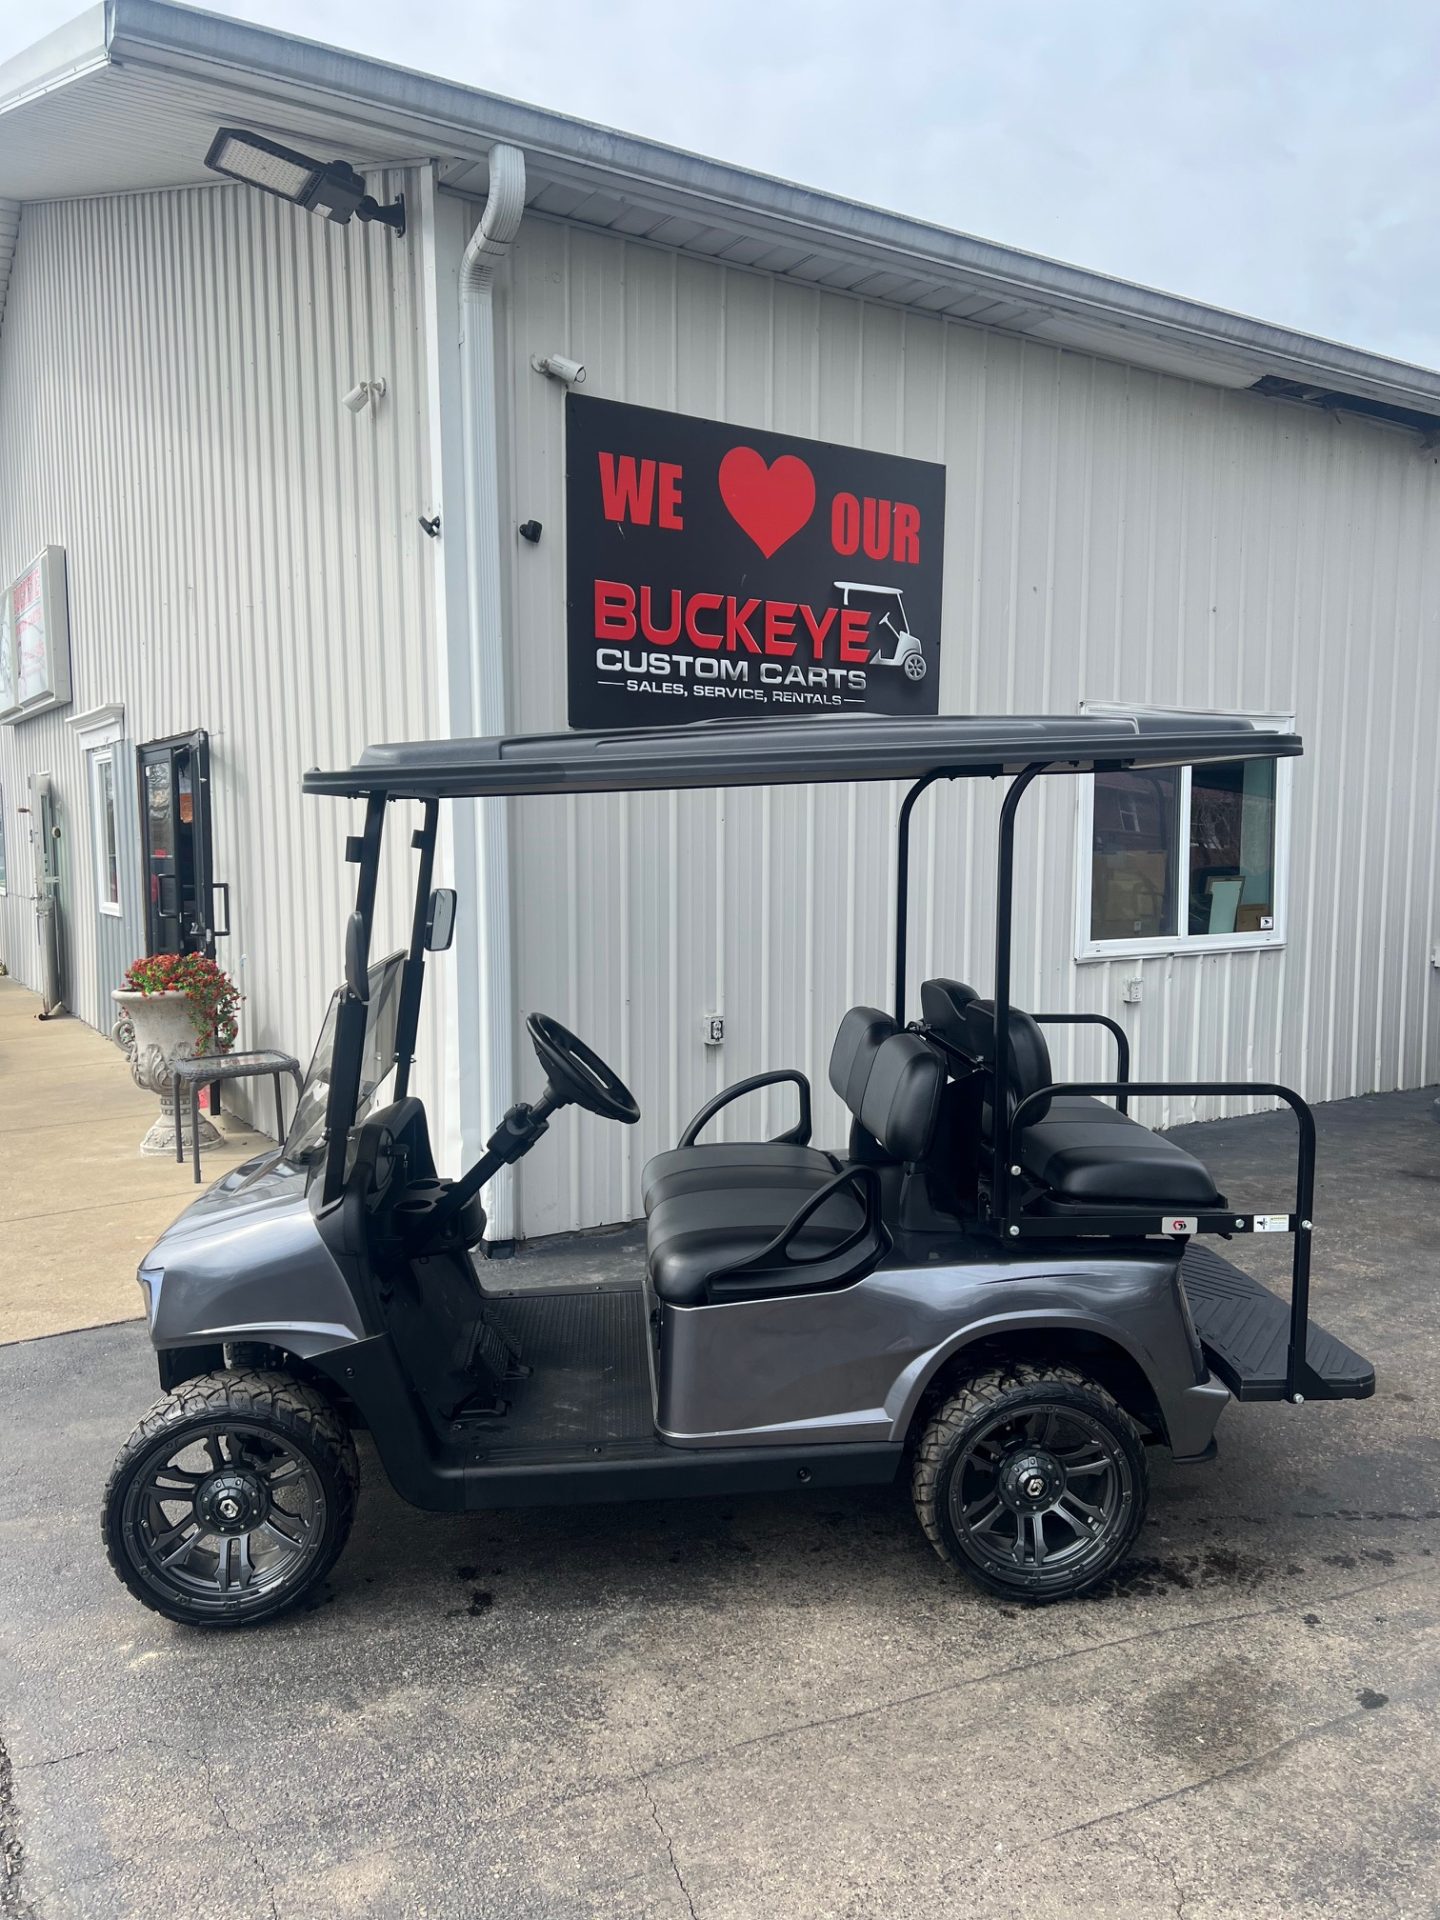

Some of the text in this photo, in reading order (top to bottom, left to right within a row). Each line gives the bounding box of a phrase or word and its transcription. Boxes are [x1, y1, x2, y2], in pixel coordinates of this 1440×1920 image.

[598, 451, 921, 564] WE OUR
[594, 579, 872, 665] BUCKEYE
[596, 648, 867, 690] CUSTOM CARTS
[626, 680, 842, 706] SALES, SERVICE, RENTALS
